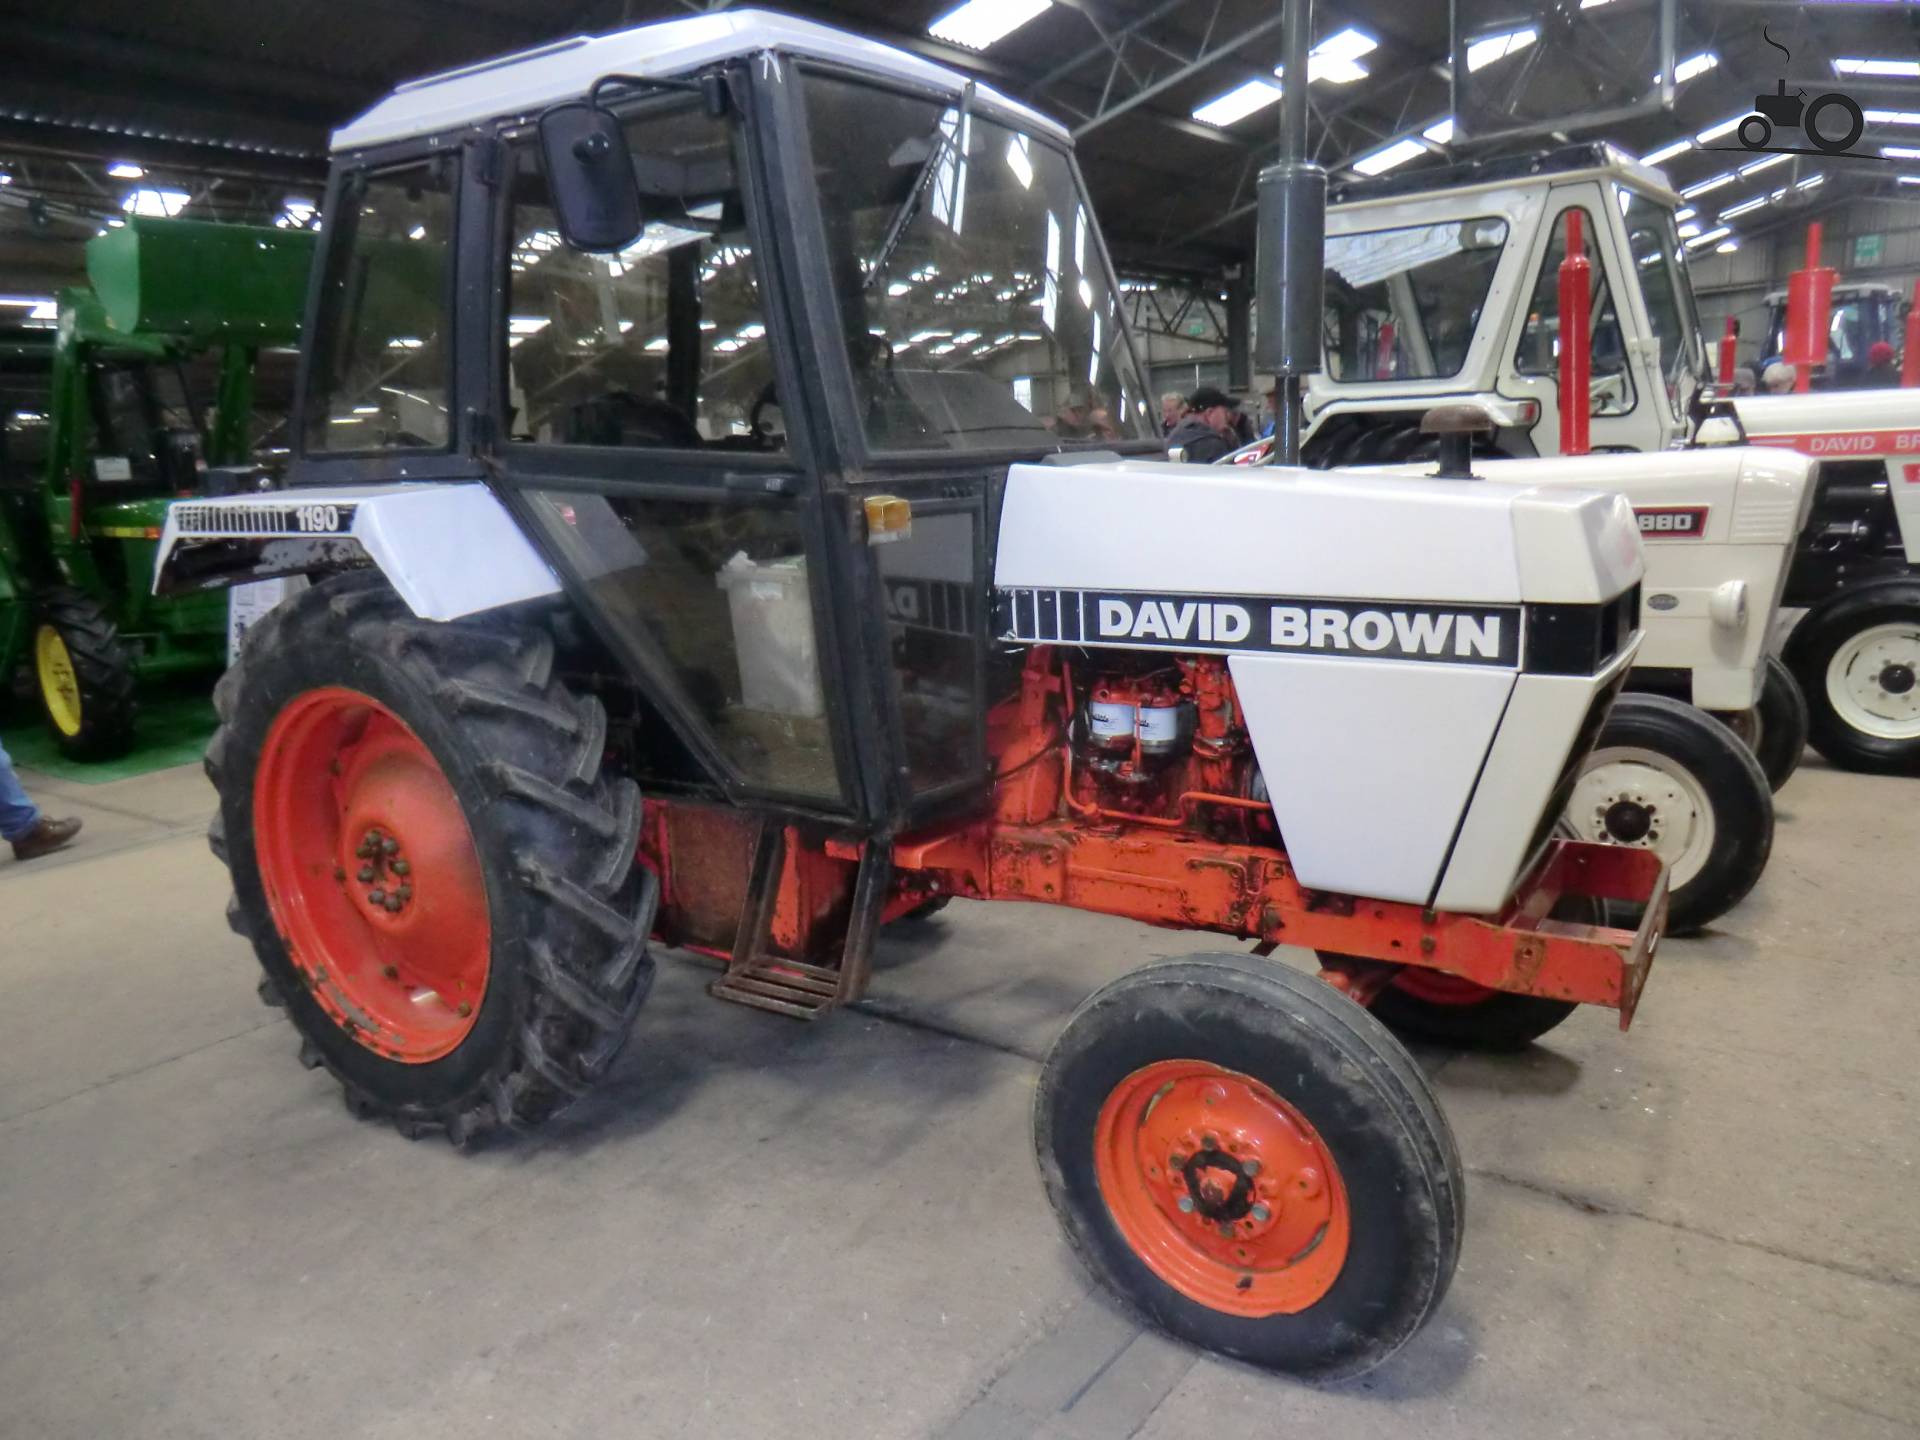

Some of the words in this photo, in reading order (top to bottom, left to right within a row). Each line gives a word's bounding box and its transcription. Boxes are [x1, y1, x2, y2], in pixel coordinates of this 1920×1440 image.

[1810, 435, 1876, 451] DAVID
[296, 505, 339, 532] 1190
[1638, 514, 1692, 531] 880
[1099, 599, 1251, 643] DAVID
[1270, 606, 1501, 658] BROWN
